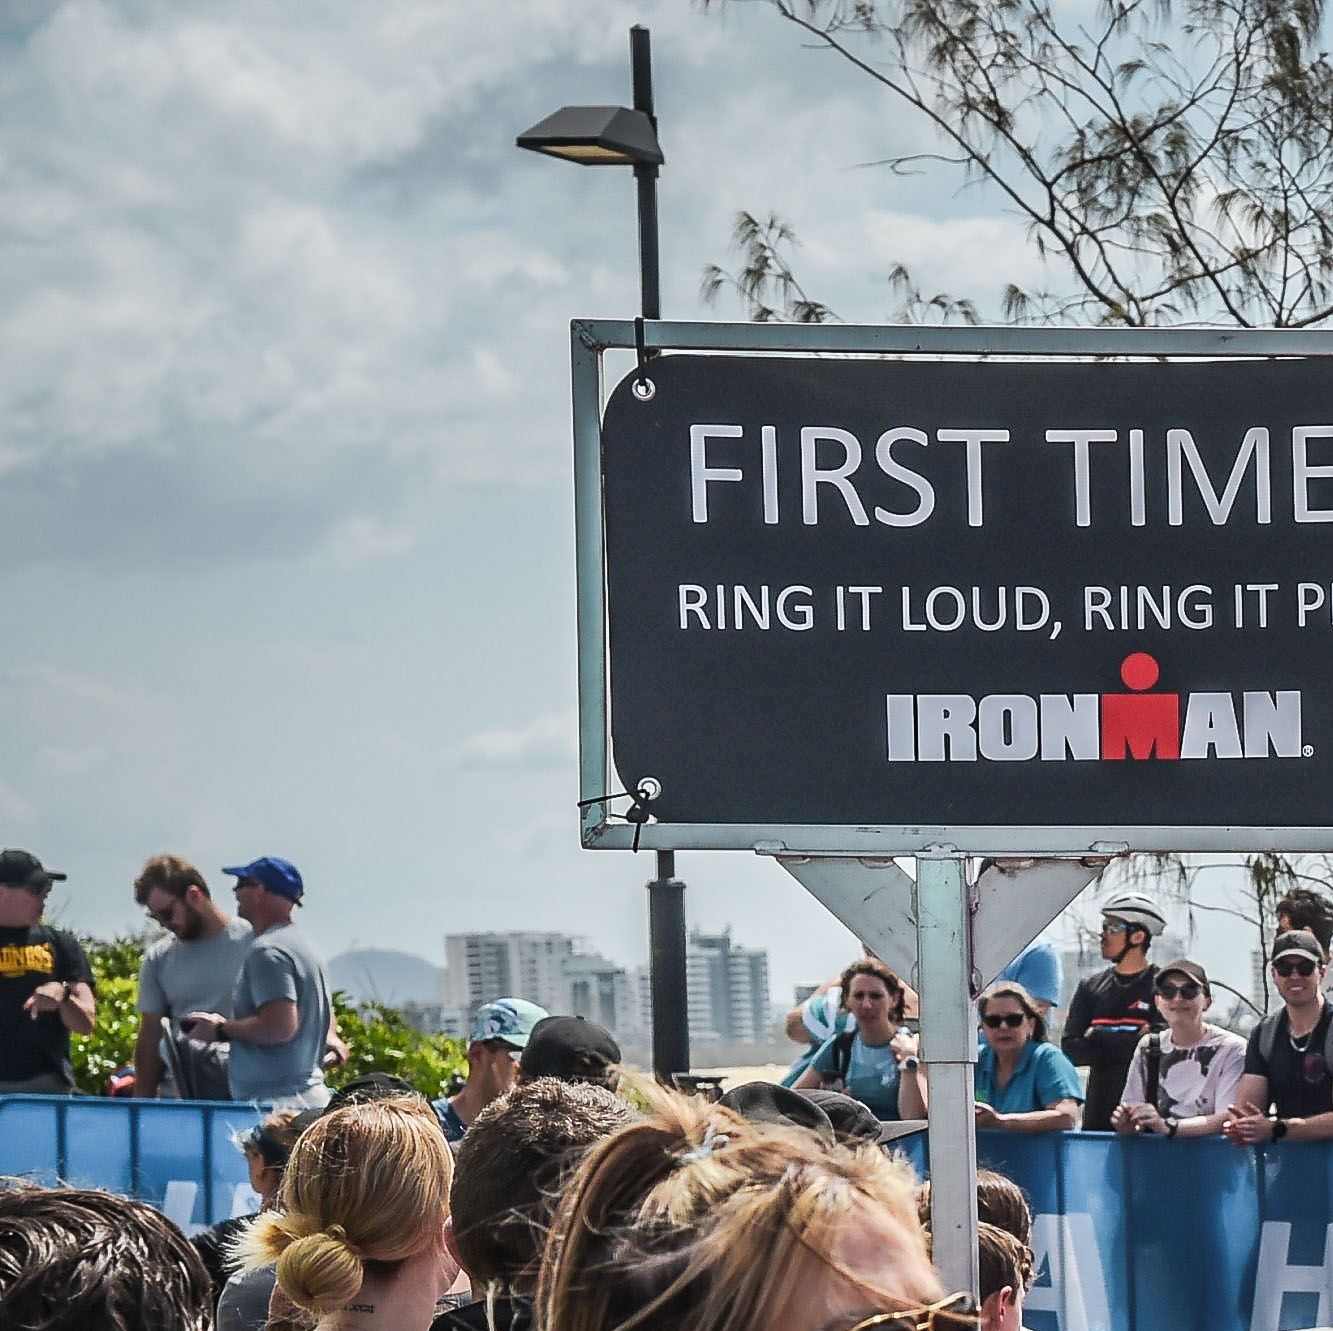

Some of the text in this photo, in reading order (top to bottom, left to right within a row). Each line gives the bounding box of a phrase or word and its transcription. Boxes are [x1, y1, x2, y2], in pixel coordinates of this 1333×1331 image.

[689, 424, 1010, 528] FIRST
[678, 584, 814, 631] RING
[836, 585, 883, 631] IT
[901, 586, 1062, 640] LOUD,
[1084, 584, 1213, 631] RING
[1234, 583, 1279, 629] IT
[886, 660, 1302, 762] IRONMAN
